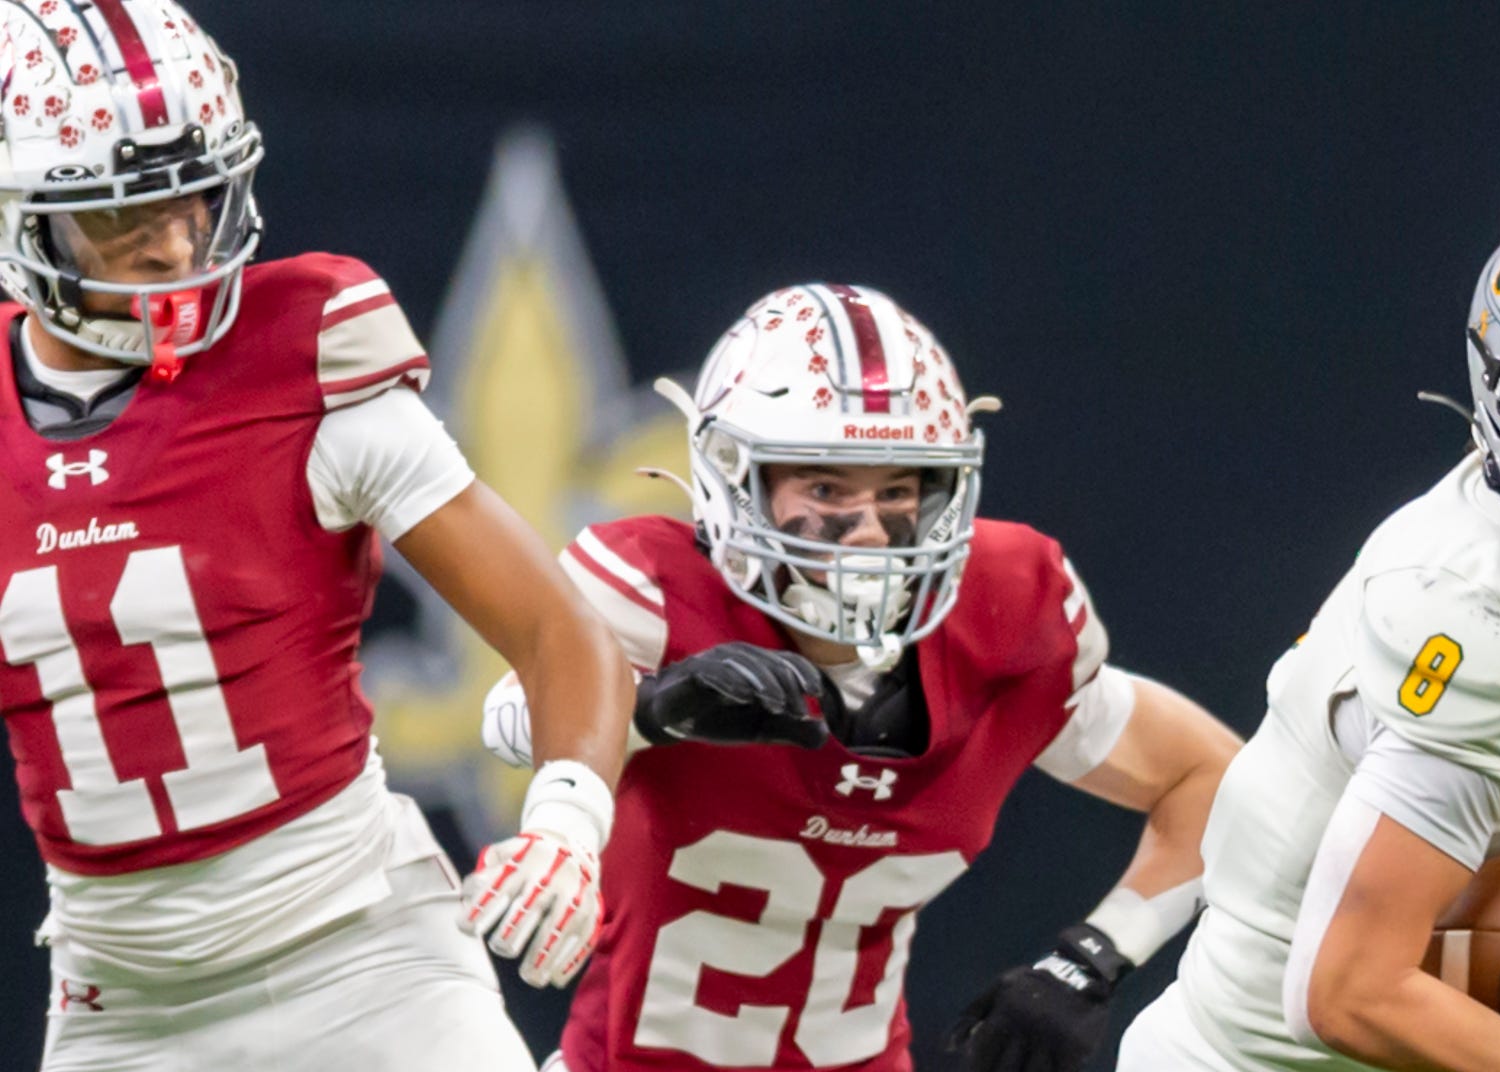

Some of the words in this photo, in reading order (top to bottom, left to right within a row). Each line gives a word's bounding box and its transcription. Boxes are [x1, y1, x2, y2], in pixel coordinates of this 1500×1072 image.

[843, 424, 914, 440] Riddell
[36, 517, 139, 554] Dunham
[0, 544, 281, 845] 11
[1398, 632, 1464, 717] 8
[799, 815, 898, 847] Dunham
[634, 829, 970, 1068] 20
